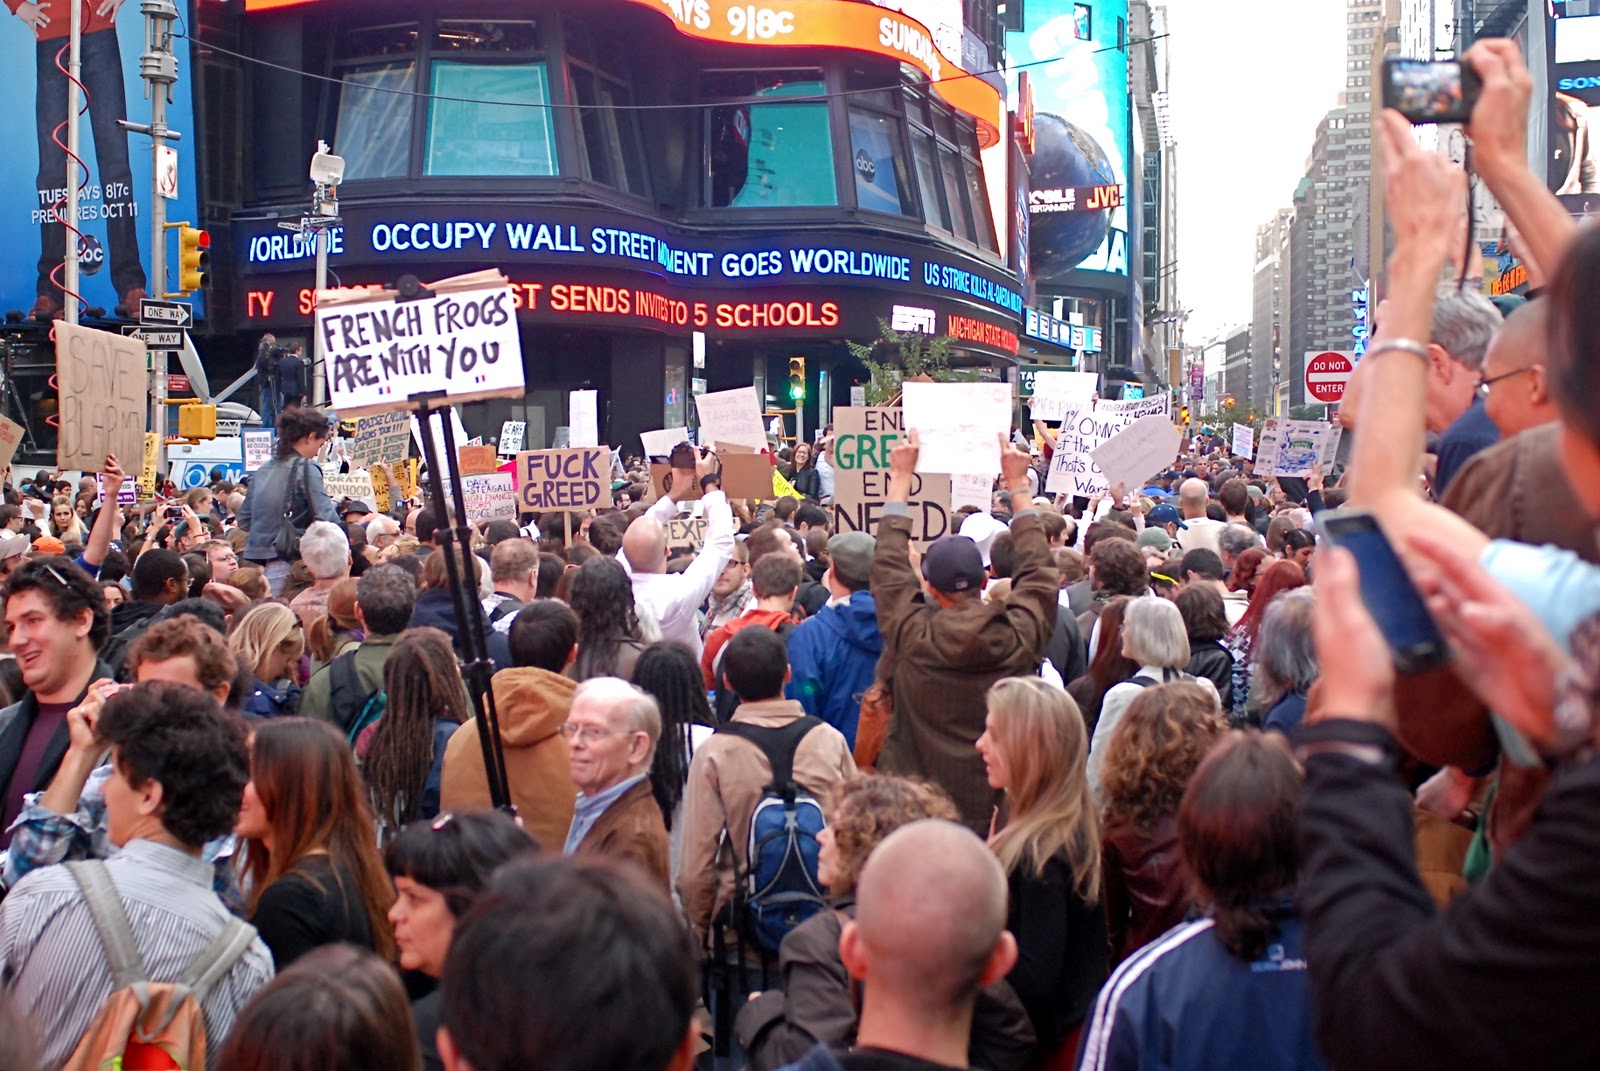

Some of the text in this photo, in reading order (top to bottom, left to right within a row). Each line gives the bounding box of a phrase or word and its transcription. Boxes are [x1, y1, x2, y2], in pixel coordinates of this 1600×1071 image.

[1558, 77, 1600, 90] SON
[856, 155, 875, 173] abc
[39, 185, 100, 204] TUESAYS
[1086, 185, 1120, 209] JVC
[31, 202, 138, 224] PREMIRES OCT 11
[372, 222, 497, 251] OCCUPY
[505, 222, 585, 252] WALL
[591, 227, 656, 262] STREET
[721, 251, 782, 277] GOES
[789, 248, 910, 281] WORLDWIDE
[924, 261, 940, 287] US
[942, 265, 970, 294] STRIKE
[148, 307, 185, 319] ONE WAY
[550, 283, 631, 314] SENDS
[635, 289, 669, 322] INVITES
[669, 299, 689, 326] TO
[693, 302, 709, 327] 5
[715, 302, 839, 327] SCHOOLS
[321, 304, 423, 352] FRENCH
[433, 291, 509, 337] FROGS
[891, 304, 936, 334] ESPN
[948, 314, 985, 343] MICHIGAN
[158, 334, 177, 343] WAY
[69, 334, 135, 402] SAVE
[333, 352, 379, 393] ARE
[437, 336, 500, 380] YOU
[1313, 361, 1346, 371] DO NOT
[1315, 384, 1344, 393] ENTER
[1061, 410, 1079, 434] 1%
[1056, 434, 1090, 453] of the
[527, 450, 600, 481] FUCK
[1055, 453, 1086, 473] That's
[466, 478, 490, 488] BACK
[523, 480, 600, 508] GREED
[465, 502, 492, 510] EFORM
[494, 506, 515, 517] MESS
